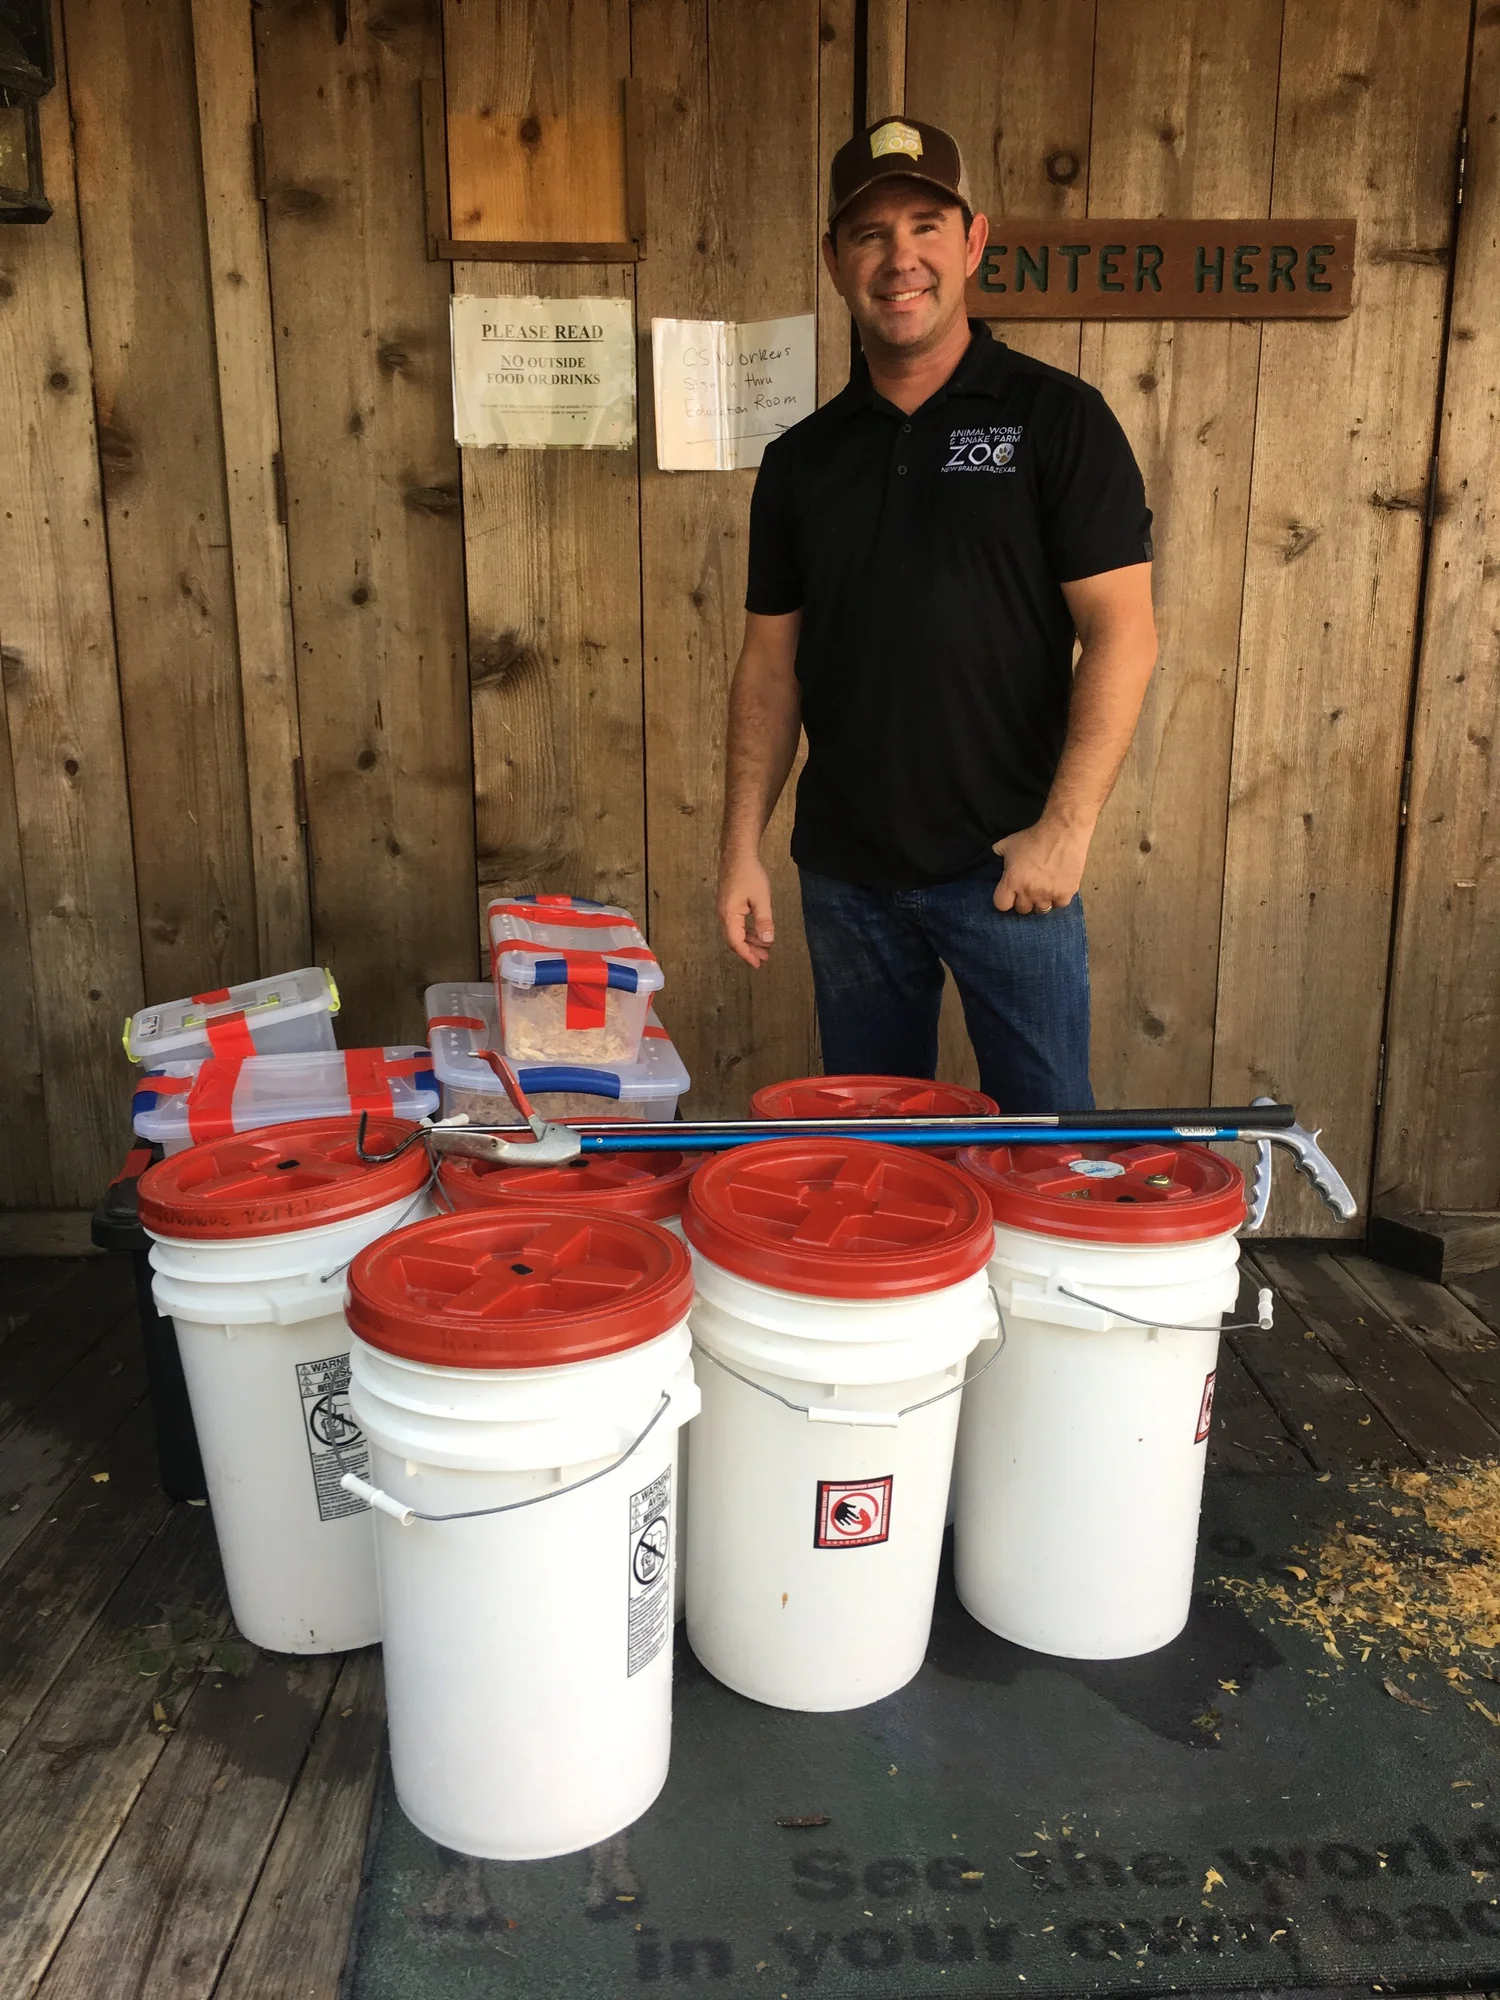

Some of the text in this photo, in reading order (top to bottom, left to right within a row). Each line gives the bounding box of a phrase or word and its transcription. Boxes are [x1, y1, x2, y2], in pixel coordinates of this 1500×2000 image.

[978, 245, 1335, 293] ENTER HERE
[482, 324, 603, 339] PLEASE READ
[501, 355, 586, 368] NO OUTSIDE
[487, 373, 601, 385] FOOD OR DRINKS
[745, 372, 773, 388] thru
[754, 394, 797, 410] Room
[950, 425, 1024, 437] ANIMAL WORLD
[960, 435, 990, 444] SNAKE
[994, 434, 1021, 443] FARM
[946, 443, 1014, 466] ZOO
[311, 1358, 350, 1372] WARN
[792, 1848, 985, 1900] See
[634, 1908, 734, 1982] in
[774, 1920, 1018, 1986] your
